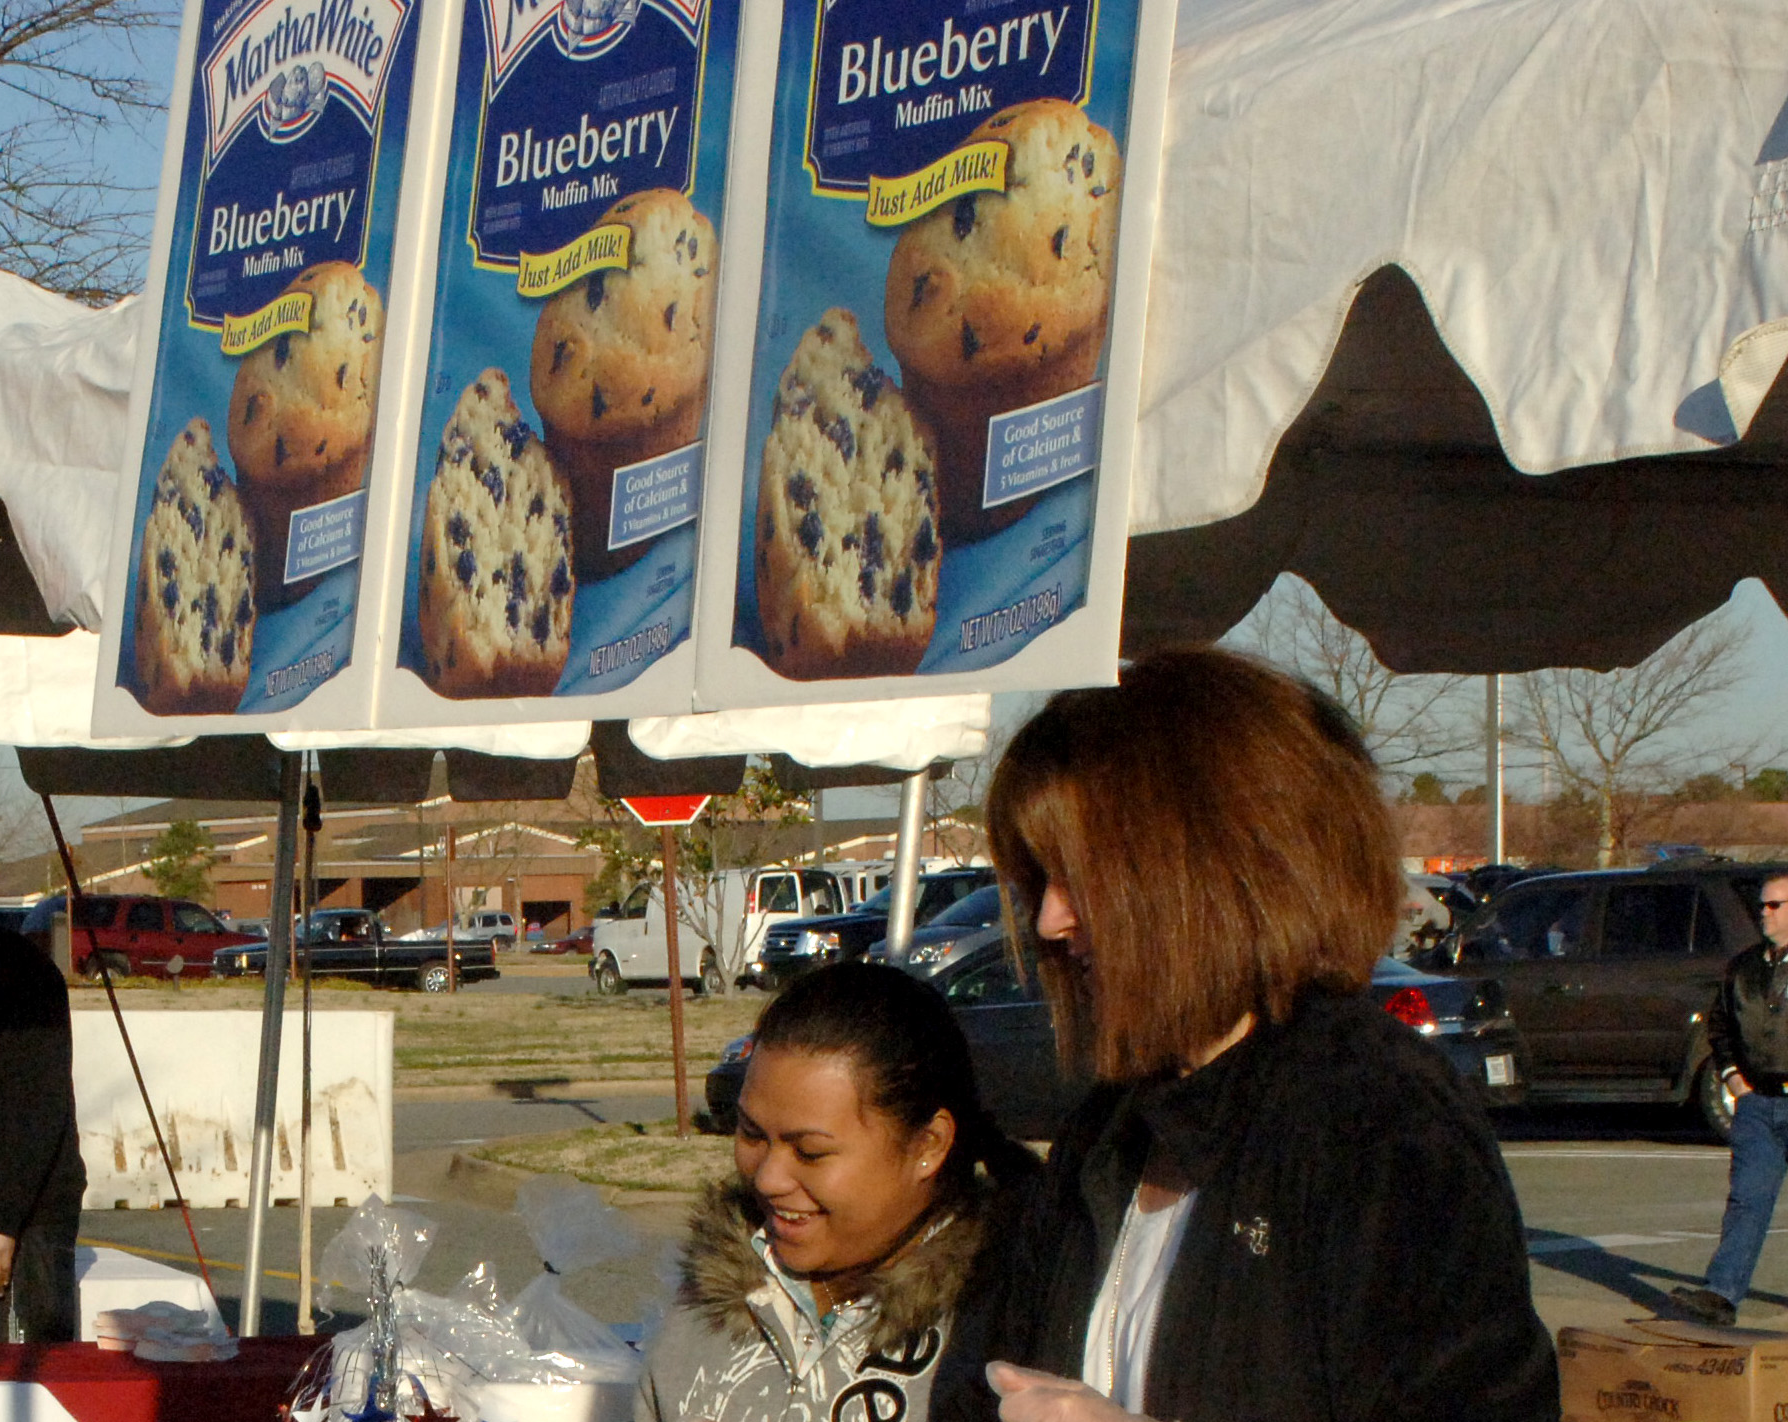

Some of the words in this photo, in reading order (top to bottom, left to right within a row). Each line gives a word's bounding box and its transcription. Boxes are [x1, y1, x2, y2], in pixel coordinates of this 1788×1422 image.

[838, 6, 1070, 104] Blueberry
[895, 94, 953, 130] Muffin
[958, 85, 993, 112] Mix
[496, 106, 679, 187] Blueberry
[542, 184, 588, 212] Muffin
[592, 173, 619, 201] Mix
[870, 184, 906, 218] Just
[910, 168, 946, 209] Add
[950, 152, 998, 187] Milk!
[209, 189, 355, 255] Blueberry
[243, 251, 281, 279] Muffin
[282, 247, 305, 270] Mix
[520, 260, 549, 289] Just
[552, 252, 581, 282] Add
[584, 236, 622, 267] Milk!
[222, 321, 248, 347] Just
[250, 313, 273, 341] Add
[274, 301, 305, 329] Milk!
[1004, 423, 1038, 445] Good
[1041, 406, 1085, 433] Source
[1002, 449, 1016, 468] of
[1018, 435, 1070, 462] Calcium
[1072, 425, 1082, 444] &
[624, 496, 636, 514] of
[637, 487, 679, 511] Calcium
[680, 478, 687, 493] &
[626, 471, 653, 493] Good
[656, 461, 689, 483] Source
[1006, 465, 1049, 488] Vitamins
[298, 540, 308, 552] of
[308, 528, 344, 549] Calcium
[300, 517, 324, 534] Good
[325, 507, 354, 528] Source
